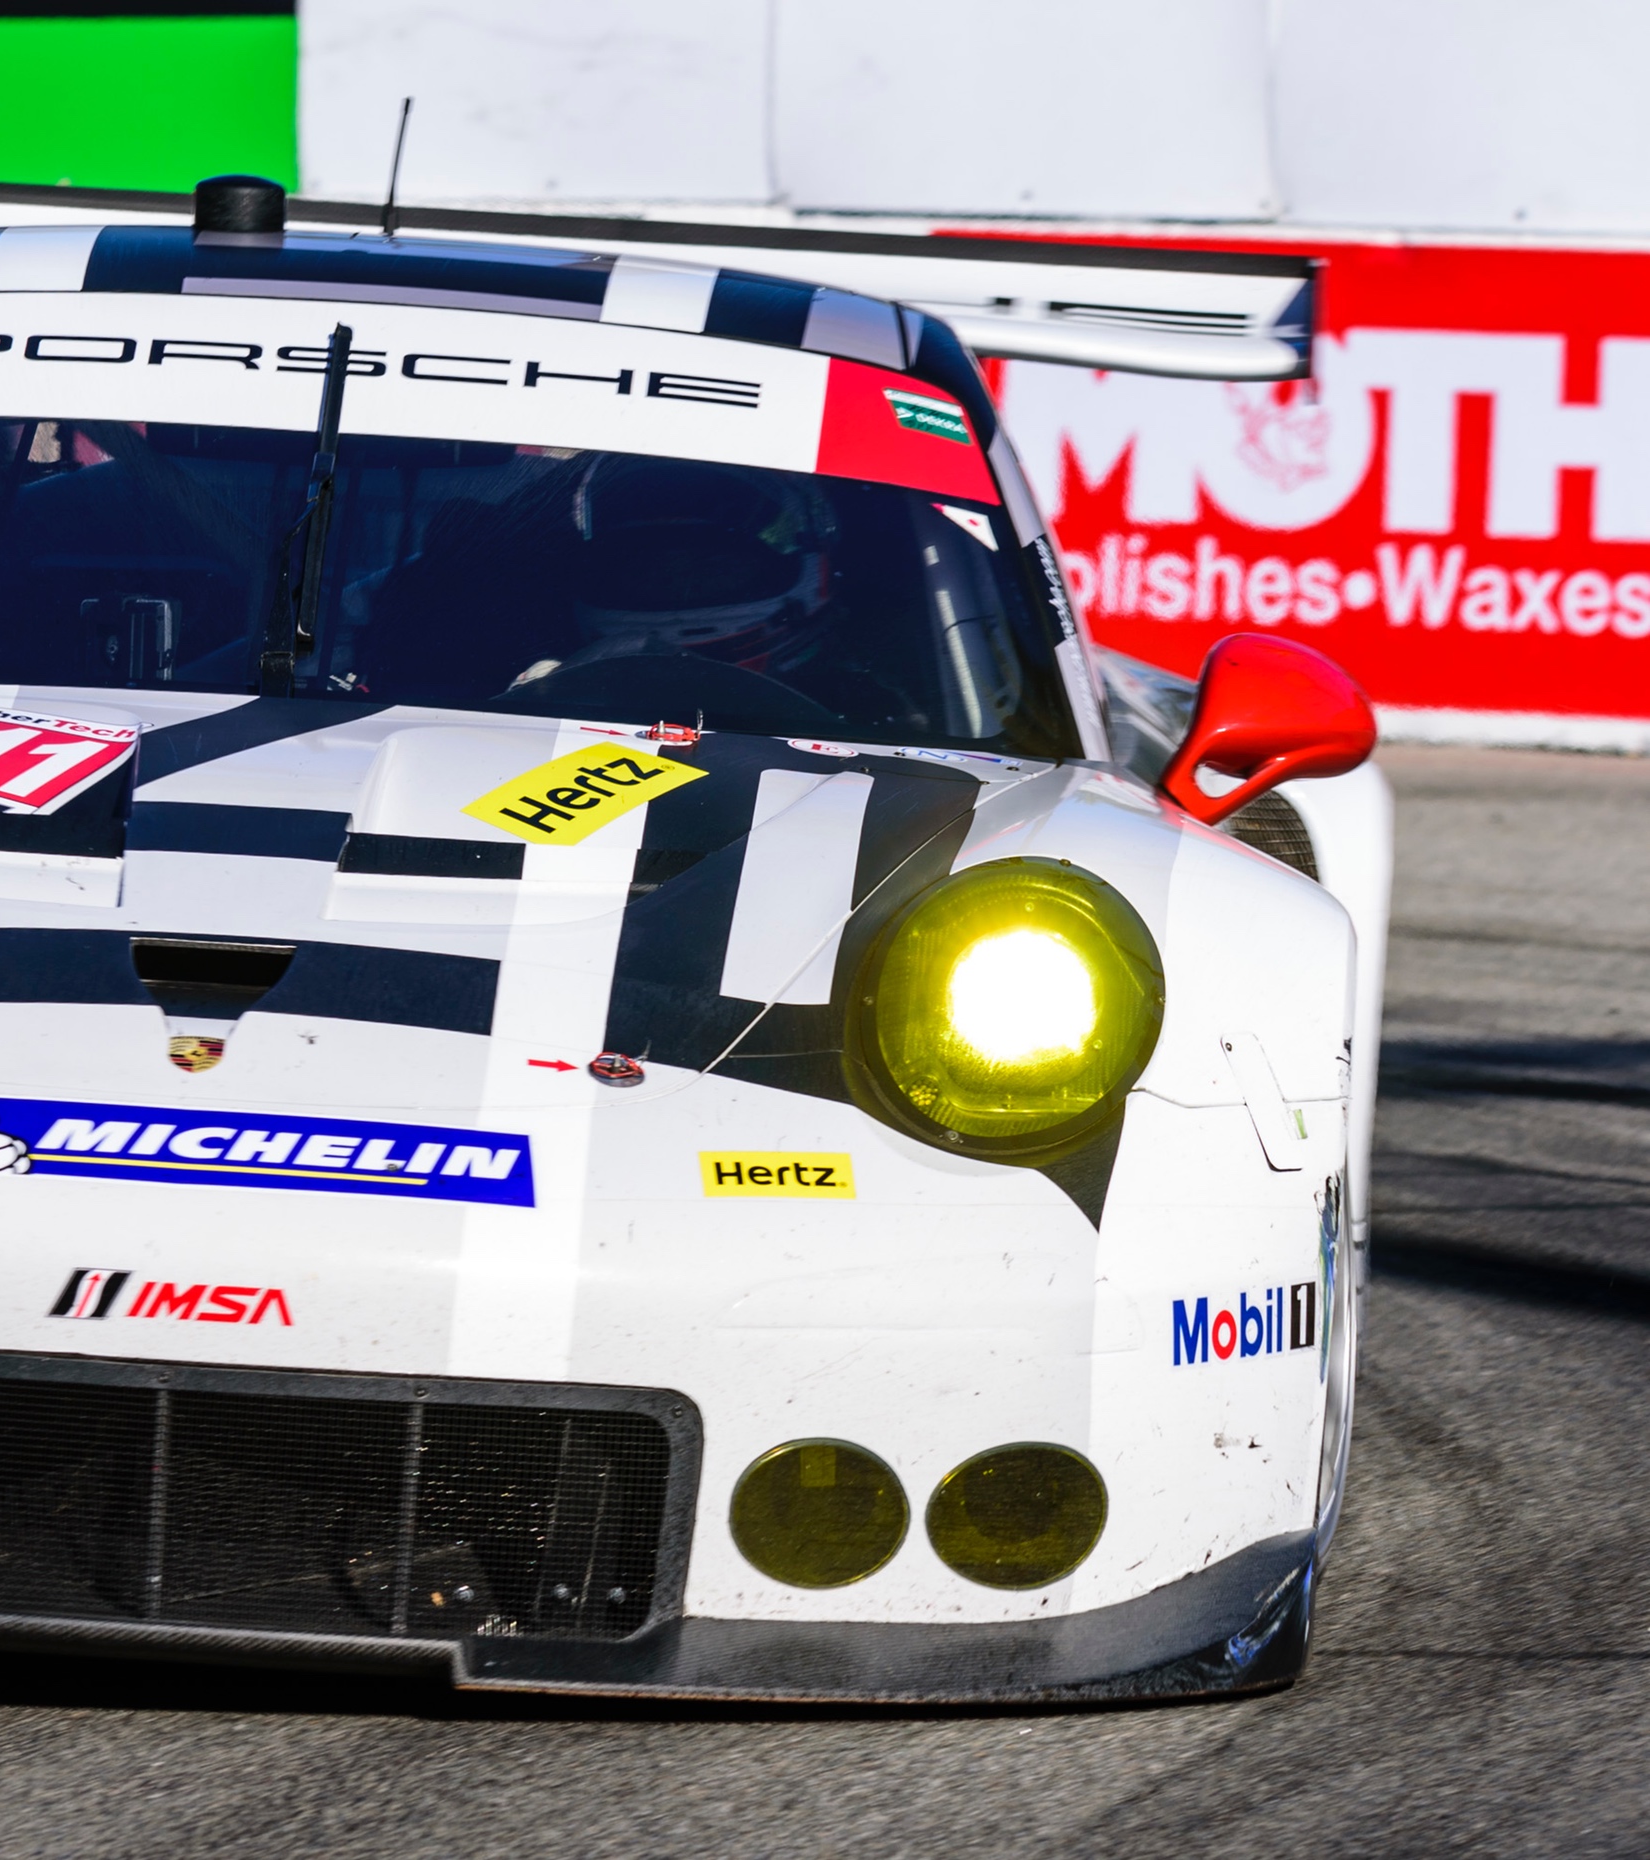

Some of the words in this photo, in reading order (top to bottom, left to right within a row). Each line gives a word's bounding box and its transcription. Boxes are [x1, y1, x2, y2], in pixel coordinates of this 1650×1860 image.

[499, 757, 666, 834] Hertz
[34, 1117, 522, 1180] MICHELIN
[714, 1161, 838, 1187] Hertz
[126, 1281, 293, 1326] IMSA
[1172, 1286, 1283, 1367] Mobil
